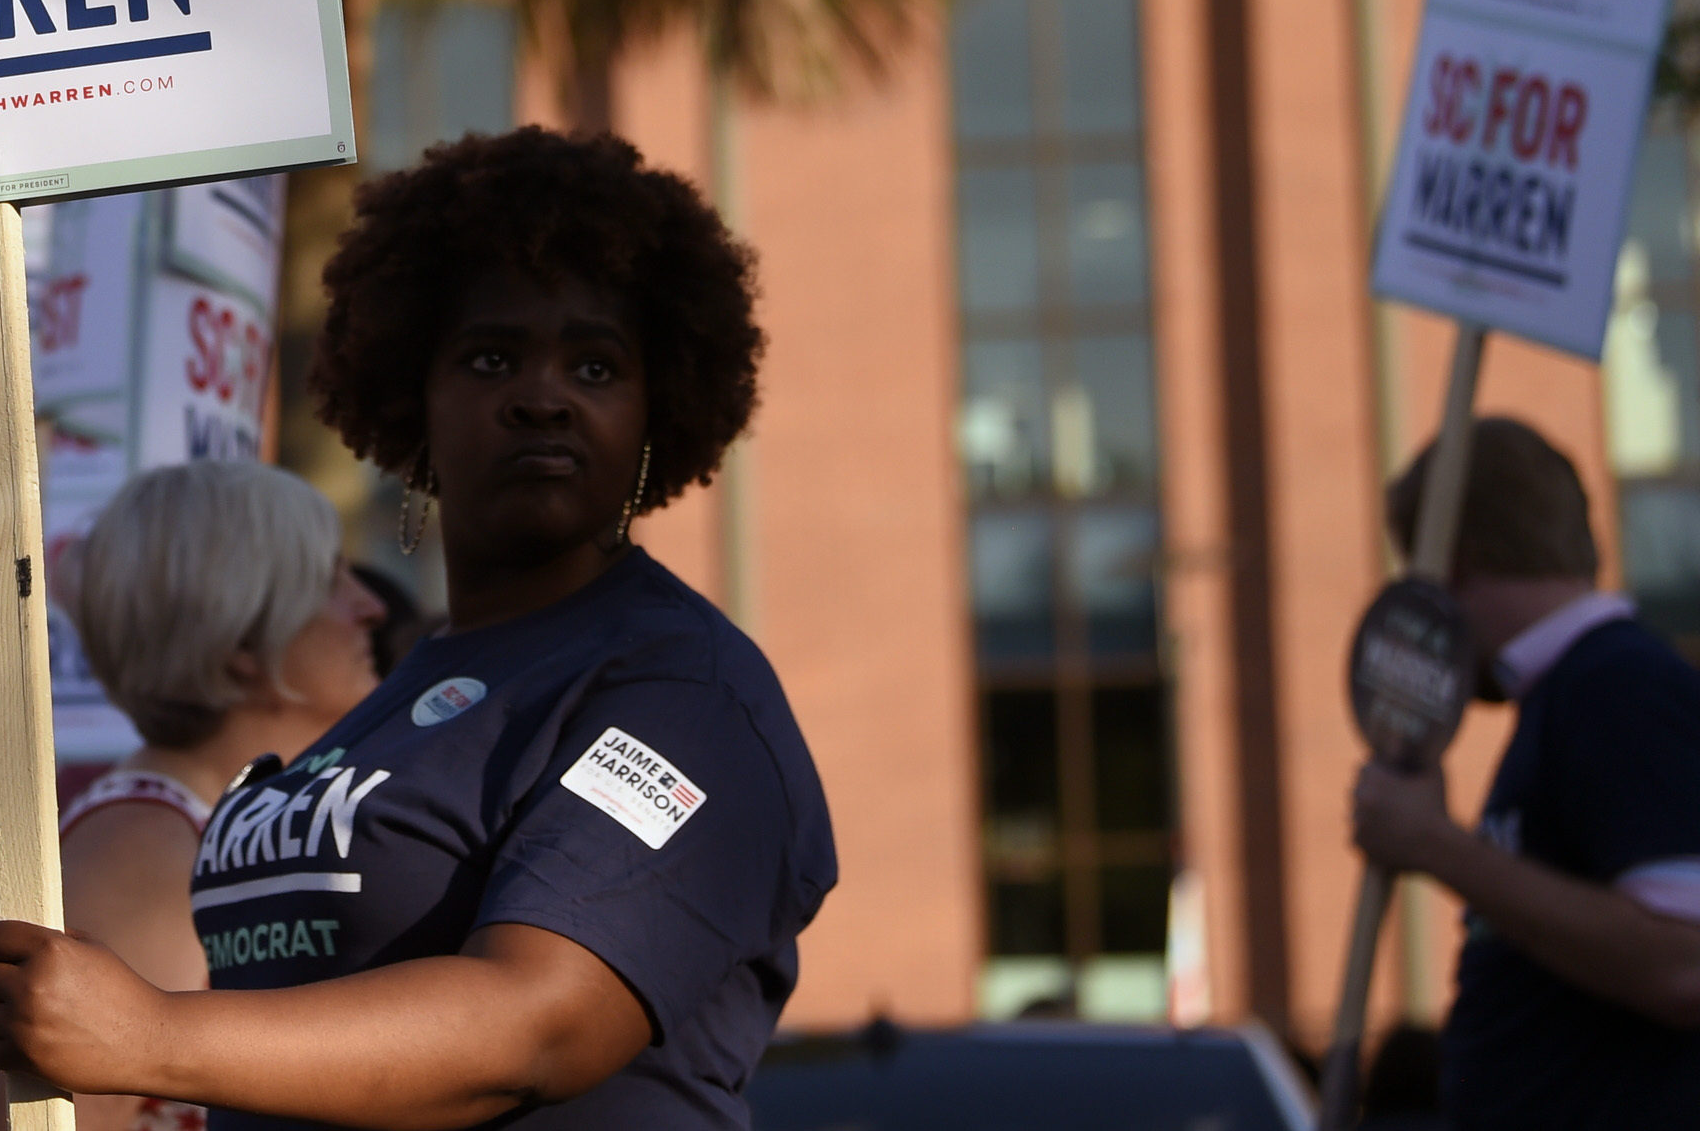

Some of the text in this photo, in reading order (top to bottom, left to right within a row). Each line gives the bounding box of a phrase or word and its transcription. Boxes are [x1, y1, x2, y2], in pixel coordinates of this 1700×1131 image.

[1424, 55, 1588, 173] SC FOR
[1, 184, 16, 192] FOR
[19, 178, 65, 189] PRESIDENT
[1410, 151, 1578, 260] WARREN
[589, 748, 685, 823] HARRISON
[603, 737, 662, 777] JAIME
[194, 766, 391, 875] ARREN
[203, 920, 339, 971] EMOCRAT
